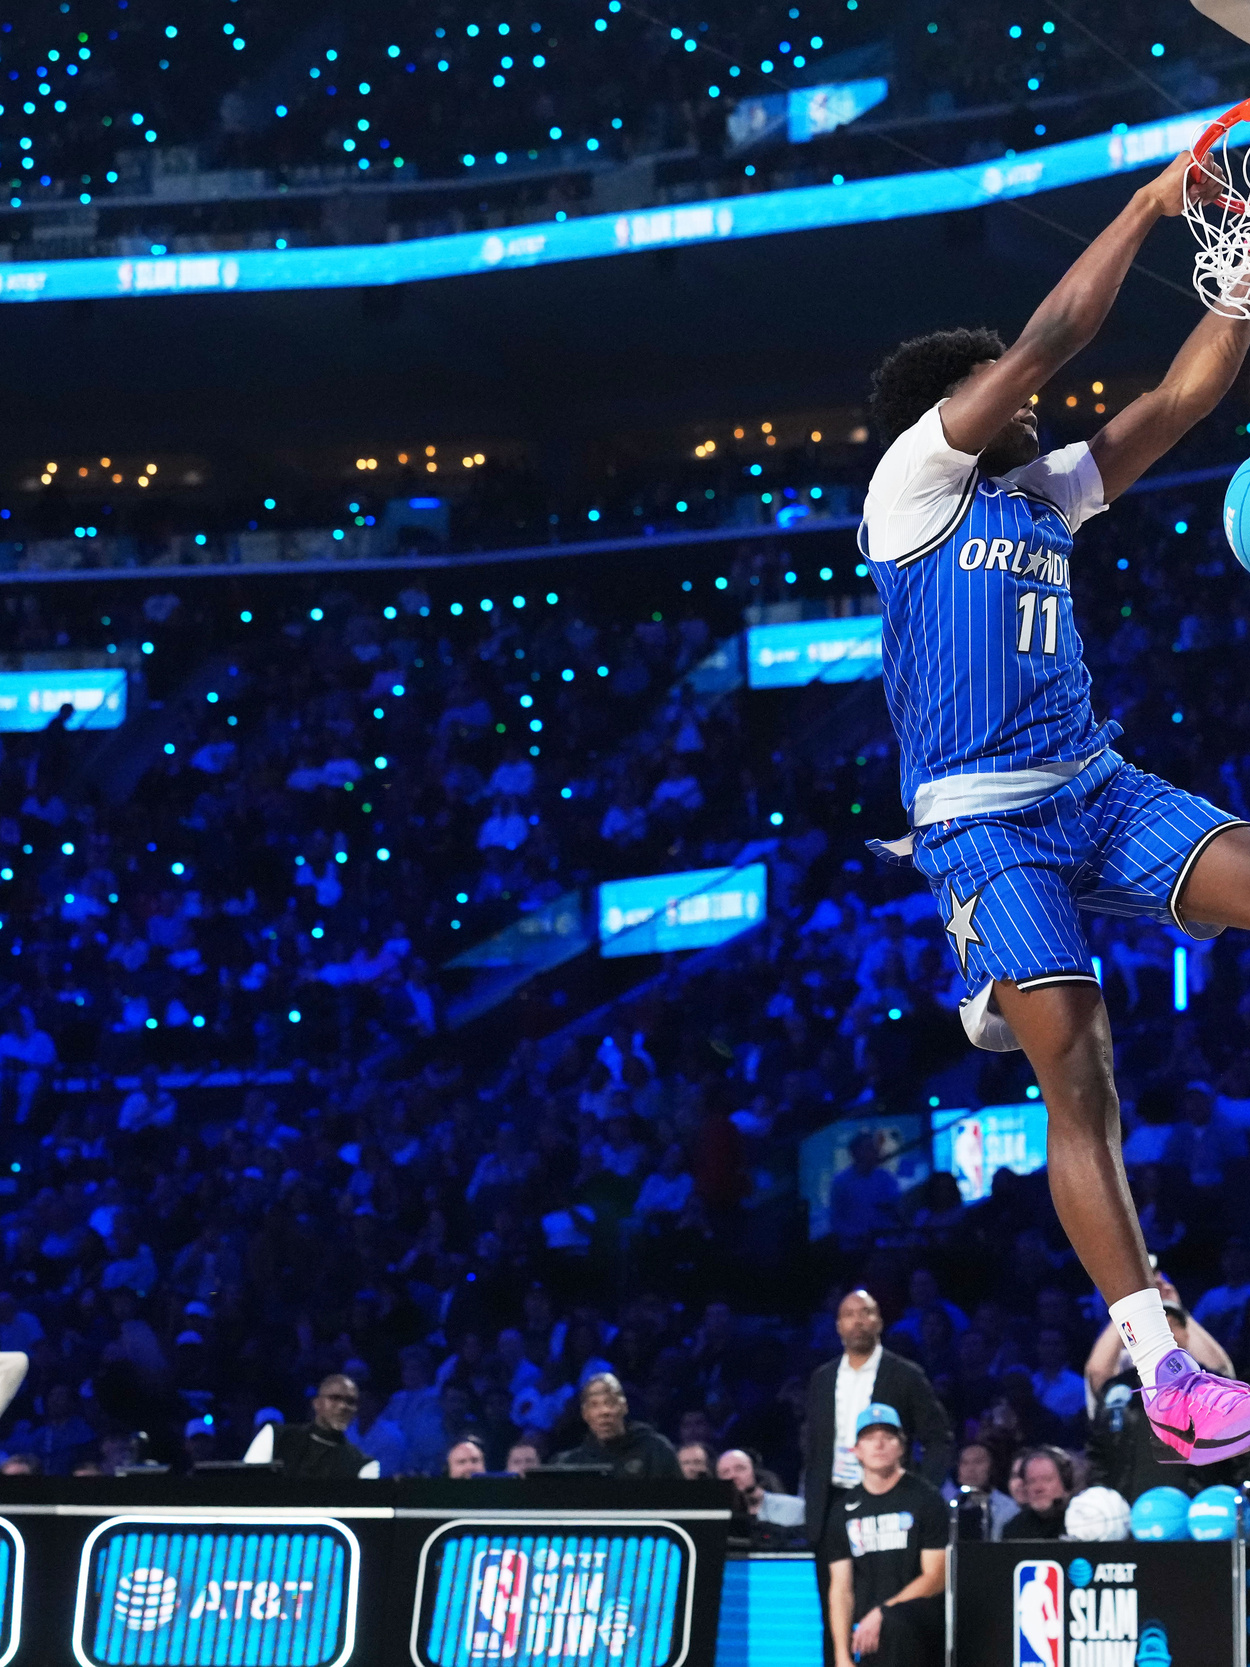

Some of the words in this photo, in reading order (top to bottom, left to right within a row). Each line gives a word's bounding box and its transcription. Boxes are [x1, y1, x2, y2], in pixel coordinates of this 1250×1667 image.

[1017, 591, 1058, 655] 11
[1093, 1562, 1138, 1583] AT&T
[189, 1580, 314, 1620] AT&T
[1069, 1588, 1138, 1640] SLAM
